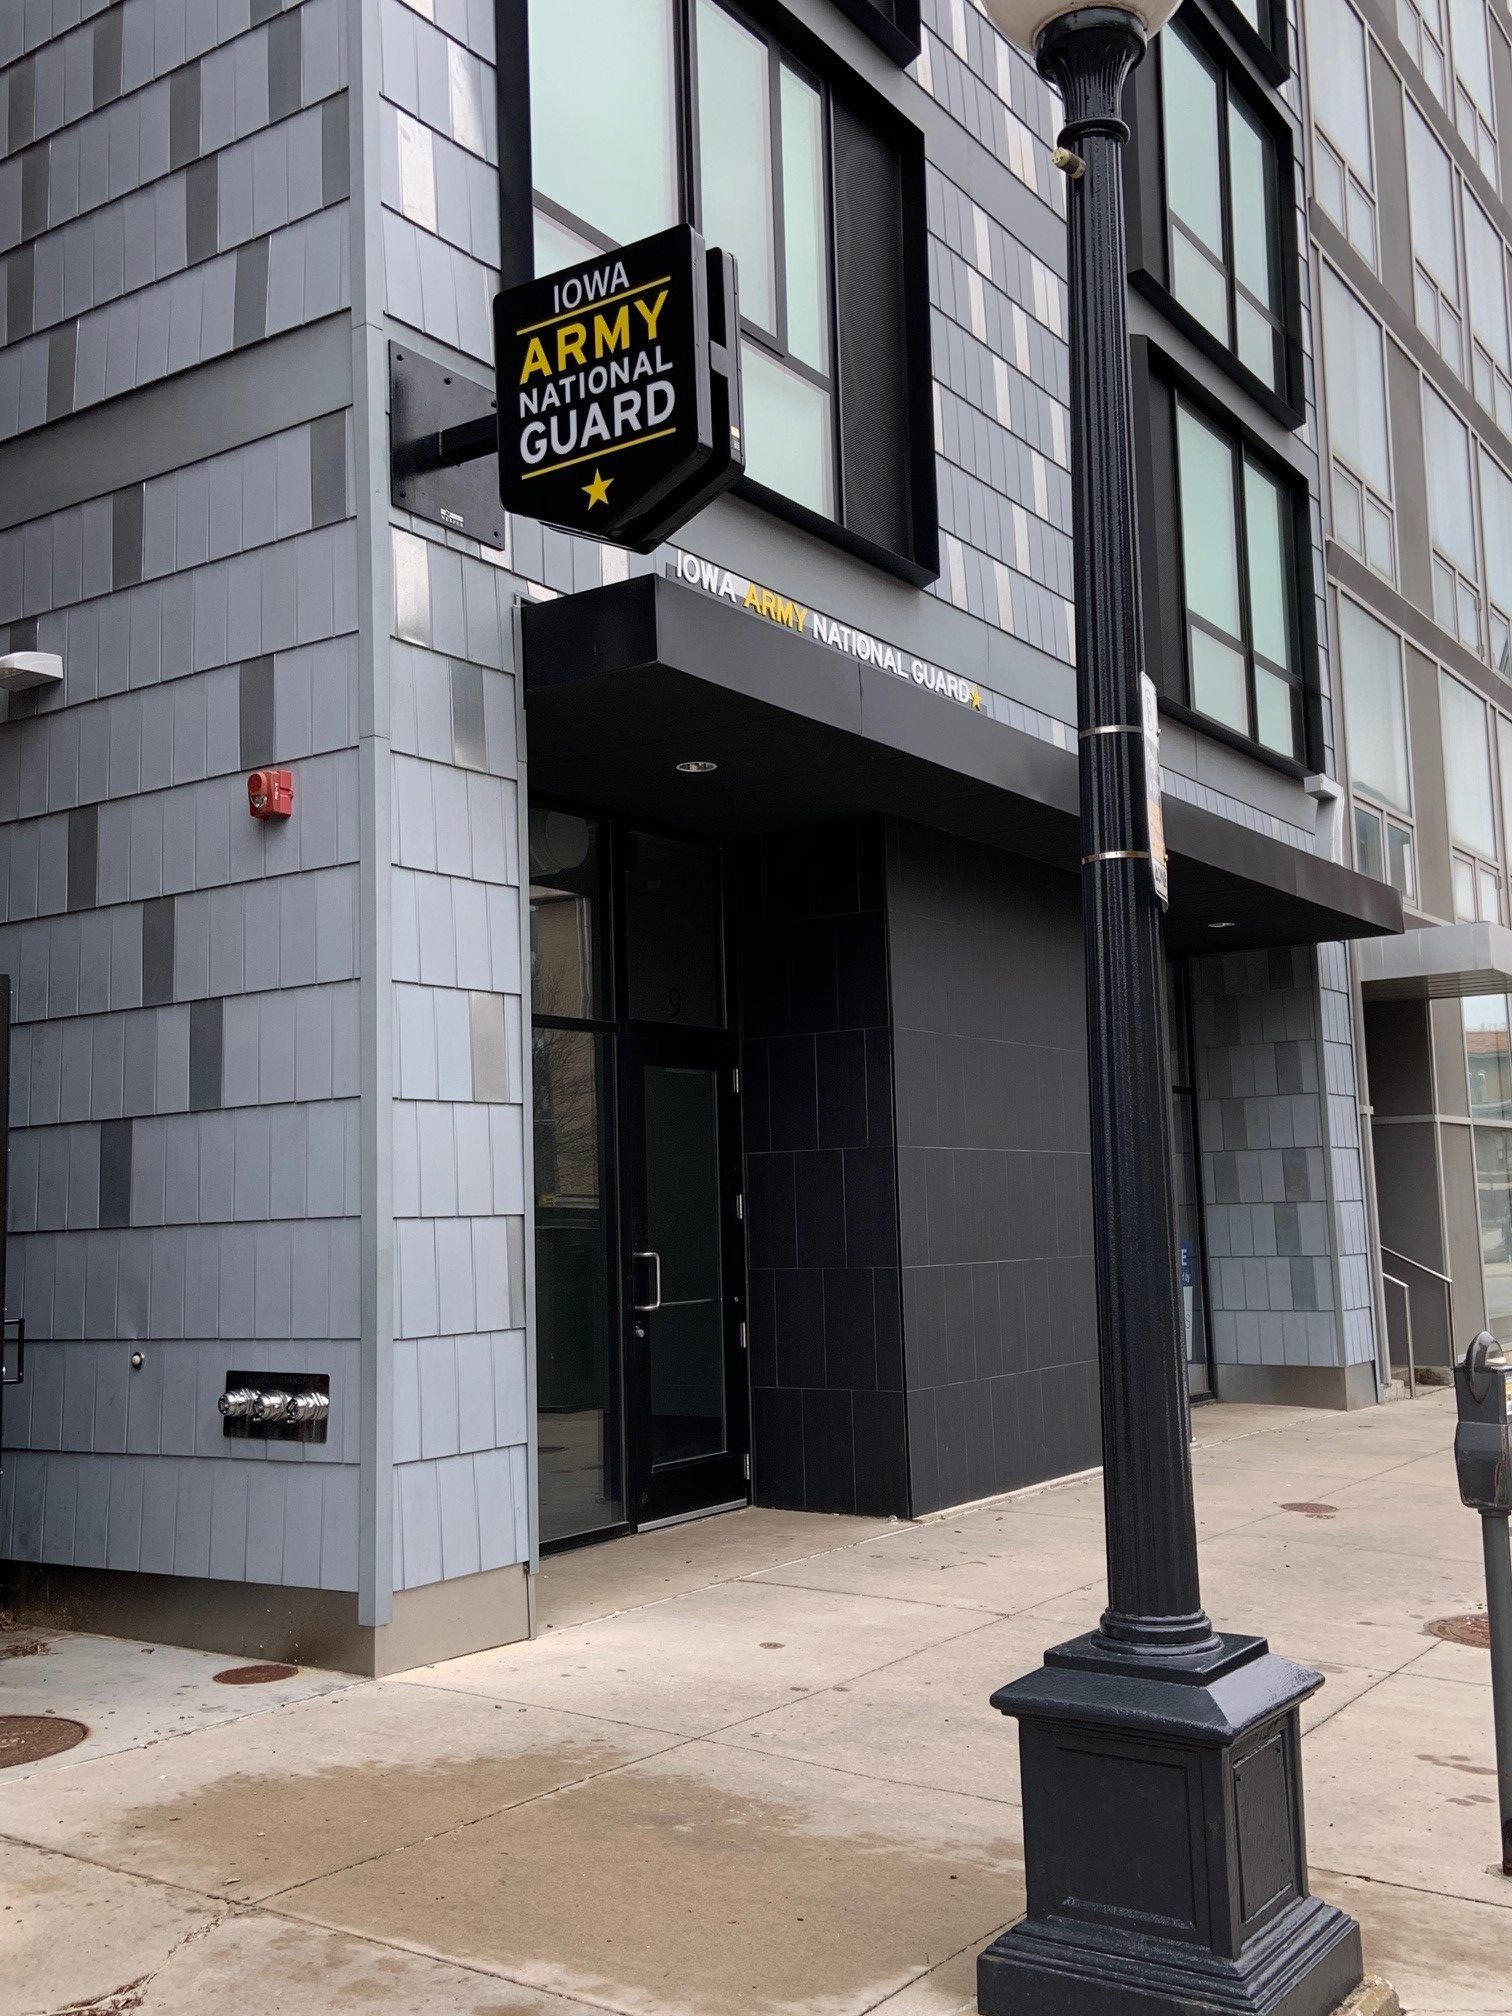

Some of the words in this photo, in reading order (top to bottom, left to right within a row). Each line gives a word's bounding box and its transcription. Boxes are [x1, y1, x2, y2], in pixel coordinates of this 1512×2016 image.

[553, 261, 630, 314] IOWA
[519, 289, 669, 385] ARMY
[519, 345, 673, 419] NATIONAL
[520, 379, 676, 465] GUARD
[675, 549, 737, 602] IOWA
[743, 582, 807, 632] ARMY
[812, 613, 909, 679] NATIONAL
[911, 660, 971, 704] GUARD
